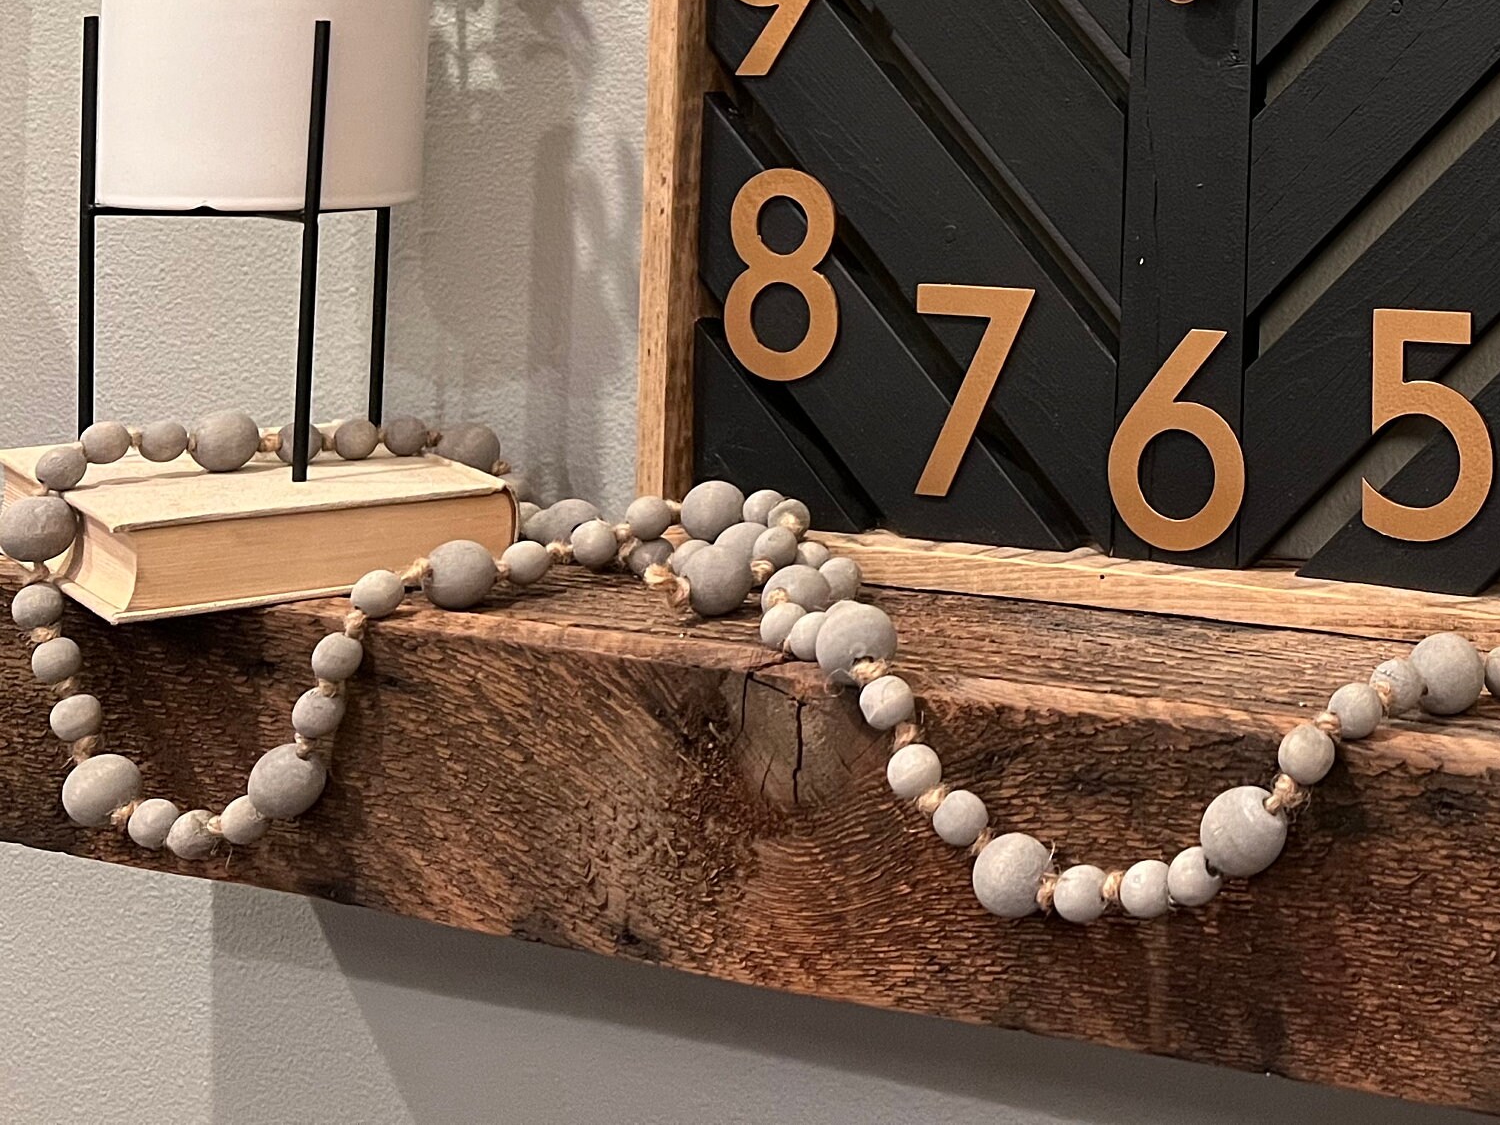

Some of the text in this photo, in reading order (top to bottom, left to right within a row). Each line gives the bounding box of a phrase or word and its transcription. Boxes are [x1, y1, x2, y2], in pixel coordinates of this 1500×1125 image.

[724, 167, 839, 382] 8
[914, 283, 1036, 497] 7
[1107, 328, 1246, 552] 6
[1361, 308, 1493, 542] 5
